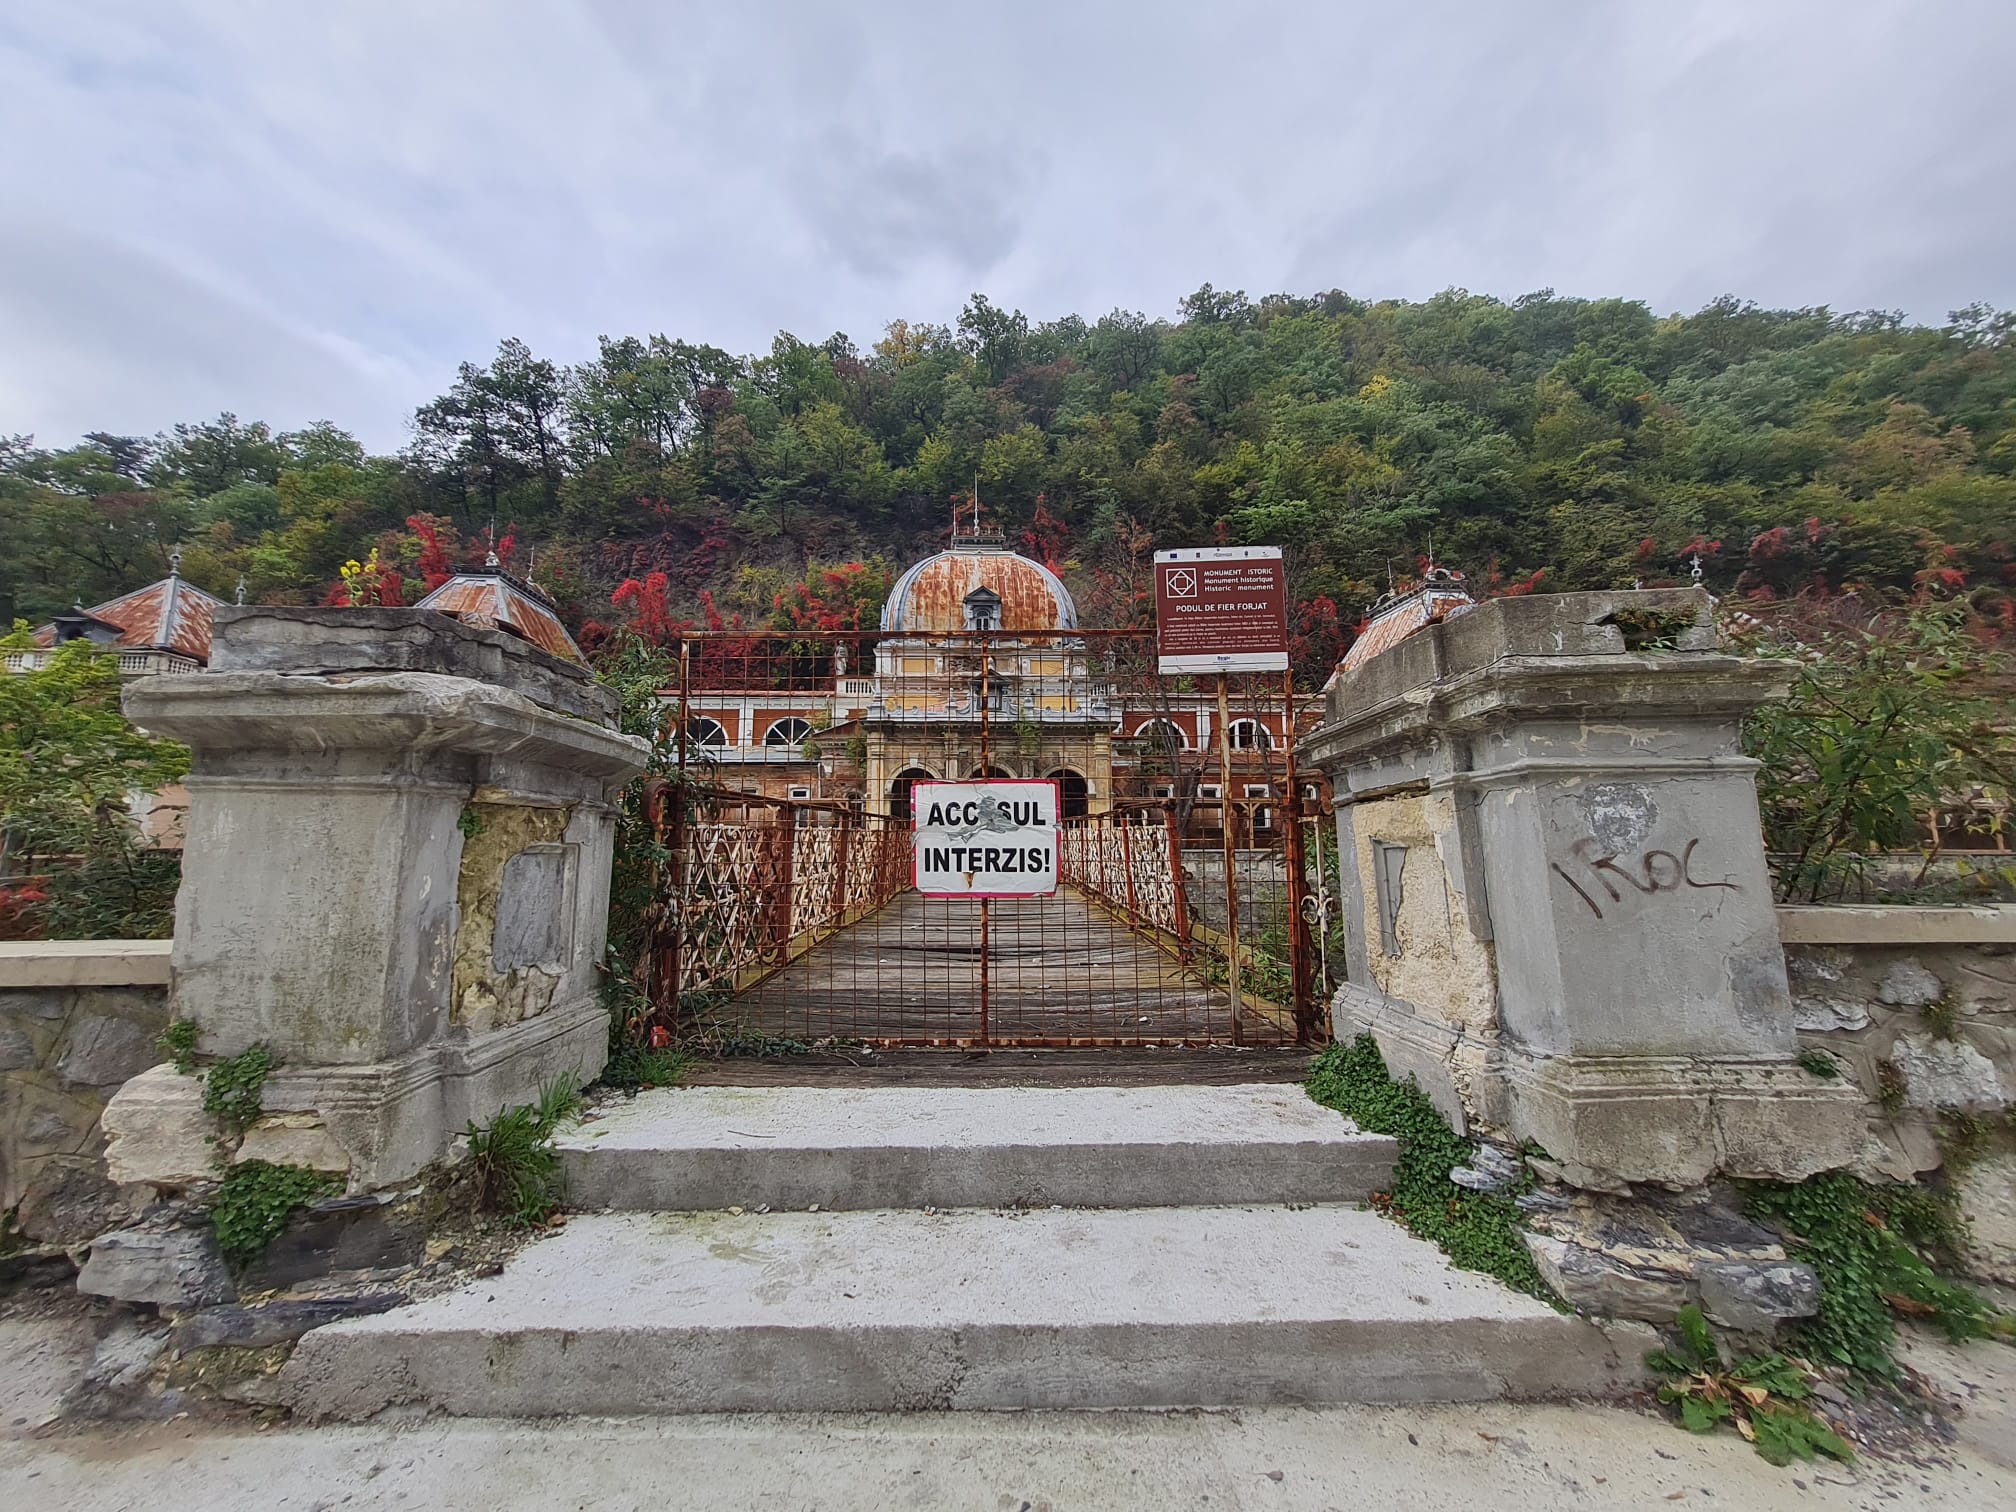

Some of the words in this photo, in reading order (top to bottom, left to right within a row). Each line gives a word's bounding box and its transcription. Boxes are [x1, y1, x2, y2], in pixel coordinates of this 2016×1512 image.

[1176, 604, 1202, 612] PODUL
[1217, 603, 1235, 611] FIER
[1237, 602, 1268, 610] FORJAT
[927, 801, 1046, 826] ACCSUL
[924, 847, 1050, 873] INTERZIS!
